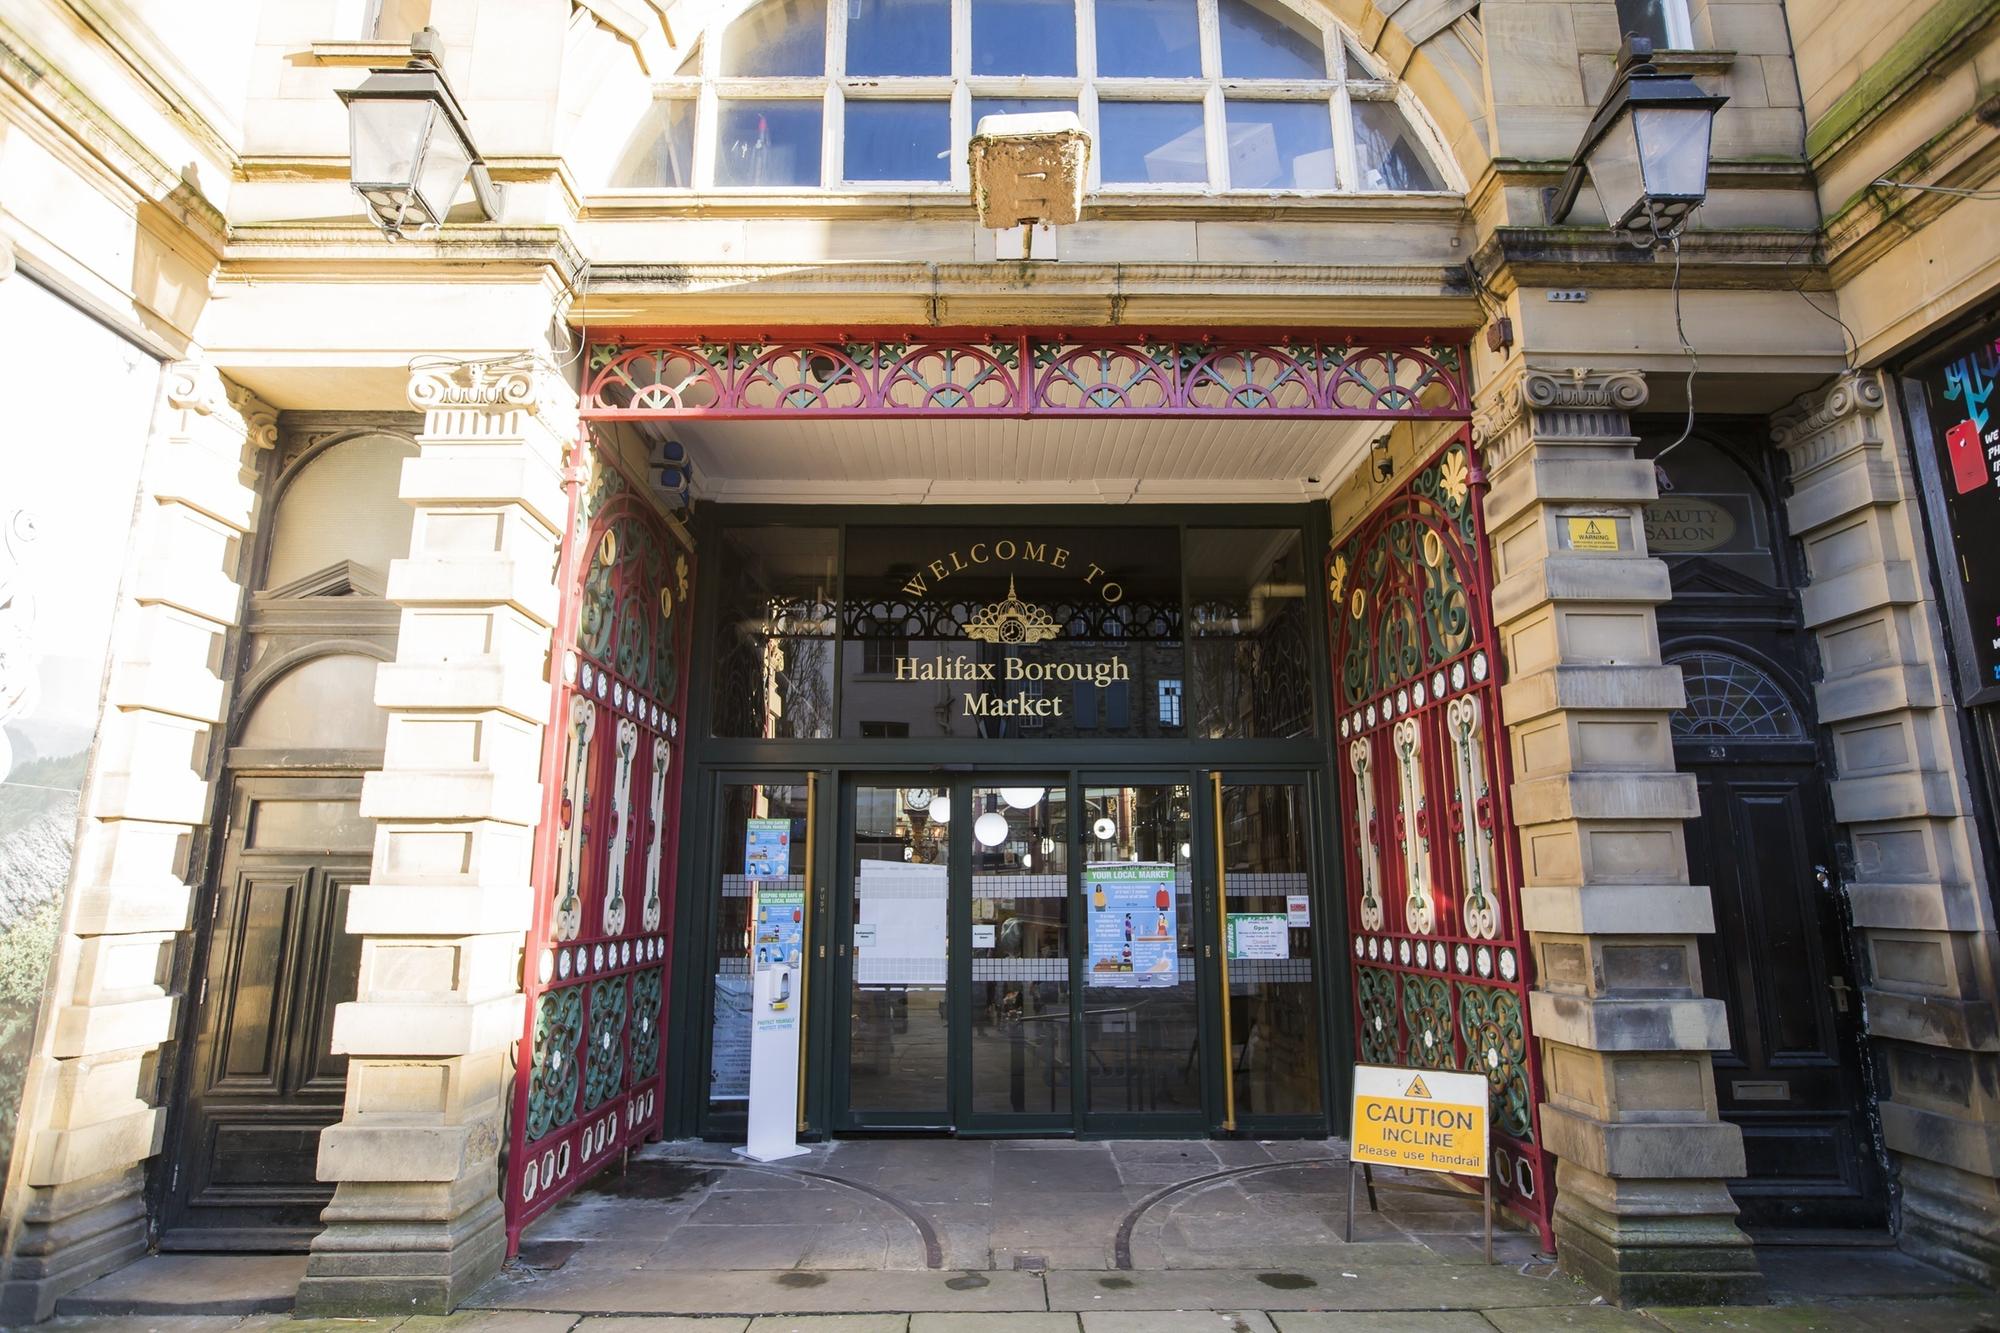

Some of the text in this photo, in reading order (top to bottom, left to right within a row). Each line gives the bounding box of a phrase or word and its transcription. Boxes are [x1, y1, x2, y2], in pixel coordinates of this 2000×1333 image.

[1985, 429, 1999, 444] WE
[1645, 524, 1715, 541] SALON
[902, 541, 1122, 602] WELCOME TO
[895, 655, 1129, 687] Halifax Borough
[962, 691, 1063, 716] Market
[1092, 870, 1169, 879] YOUR LOCAL MARKET
[1366, 1103, 1473, 1130] CAUTION
[1383, 1127, 1454, 1148] INCLINE
[1358, 1143, 1480, 1167] Please use handrail
